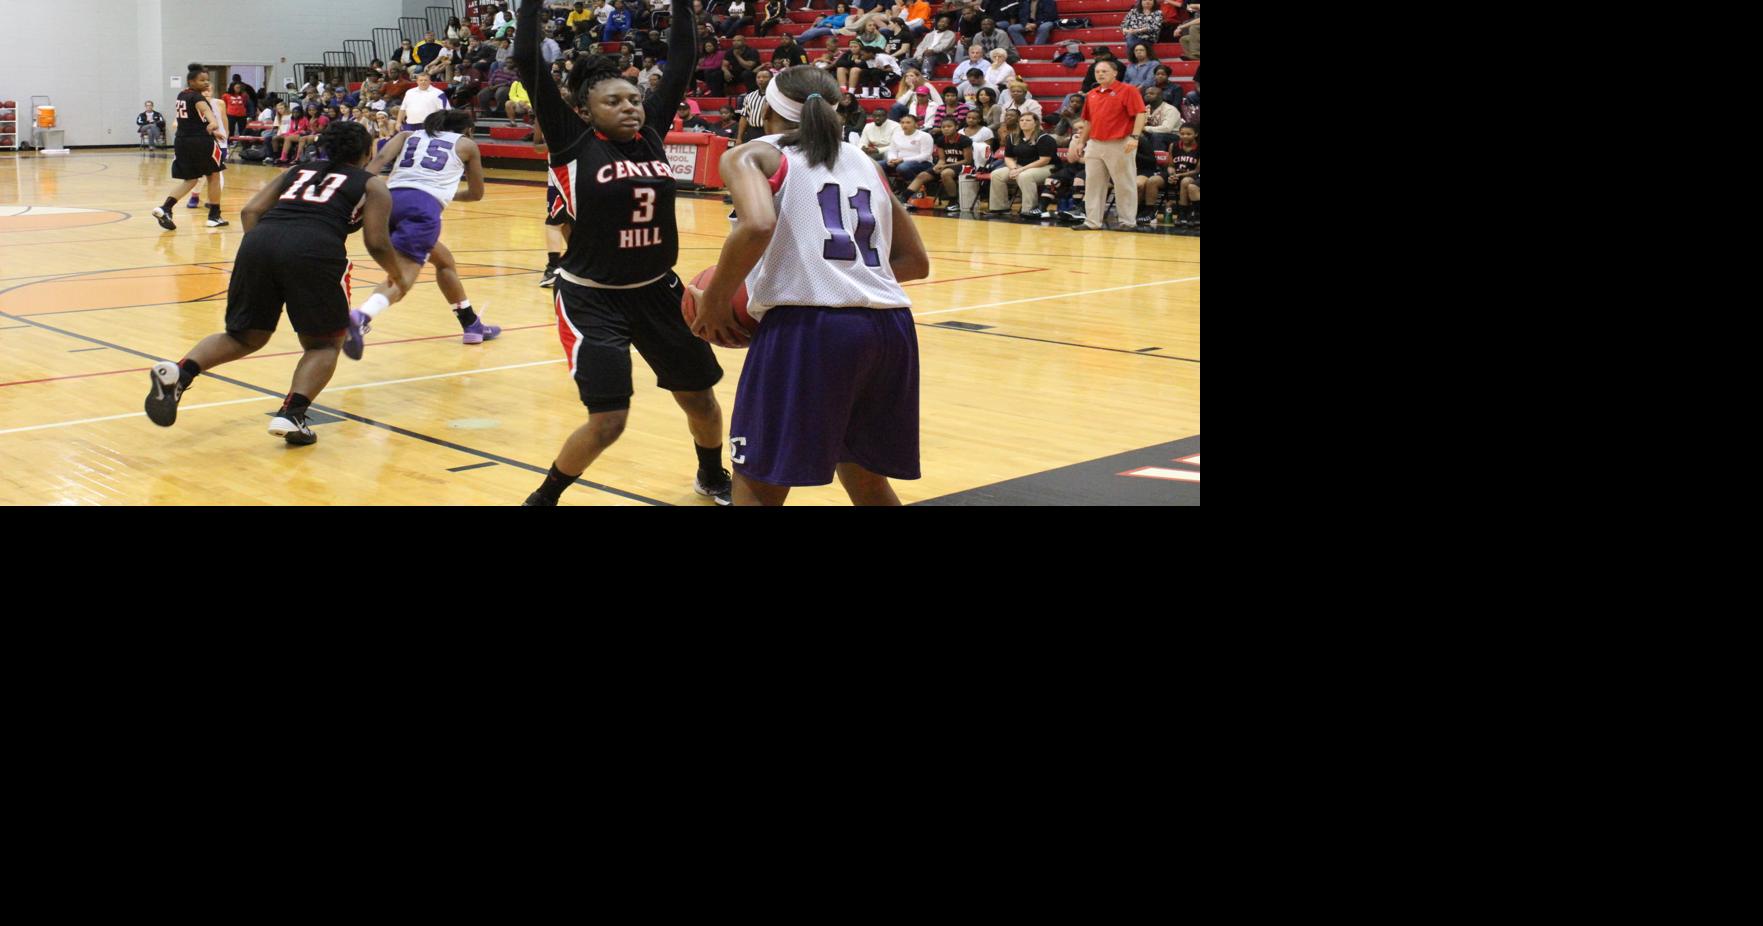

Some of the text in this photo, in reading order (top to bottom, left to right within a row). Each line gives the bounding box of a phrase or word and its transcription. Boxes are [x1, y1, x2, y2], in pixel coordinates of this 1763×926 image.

[399, 136, 454, 171] 15
[670, 144, 695, 154] HILL
[279, 169, 348, 203] 13
[632, 187, 656, 223] 3
[619, 227, 662, 249] HILL
[816, 182, 881, 267] 11
